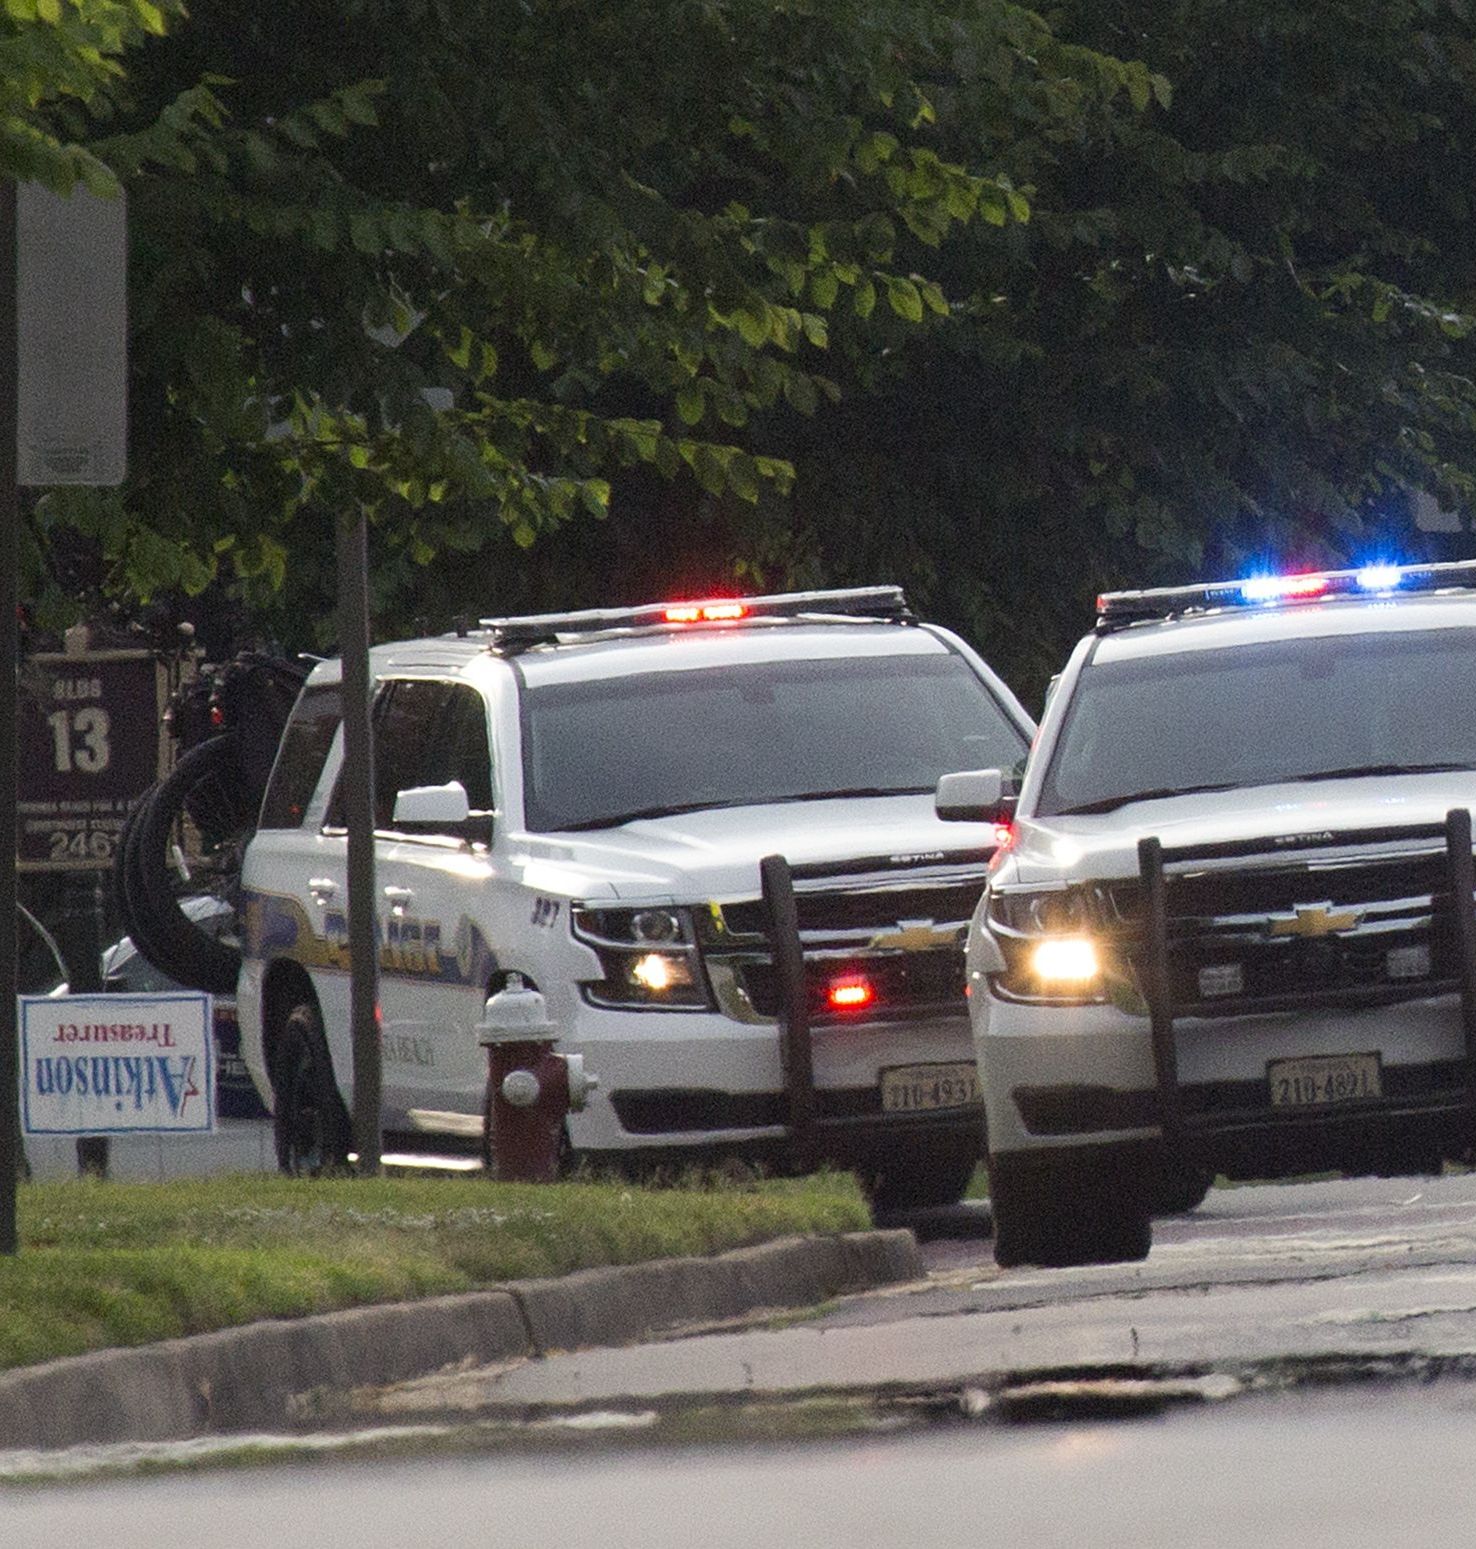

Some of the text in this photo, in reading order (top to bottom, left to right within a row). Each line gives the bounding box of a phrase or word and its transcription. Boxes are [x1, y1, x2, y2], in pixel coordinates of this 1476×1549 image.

[48, 707, 111, 773] 13
[53, 1023, 176, 1047] Treasurer
[36, 1055, 195, 1118] Atkinson
